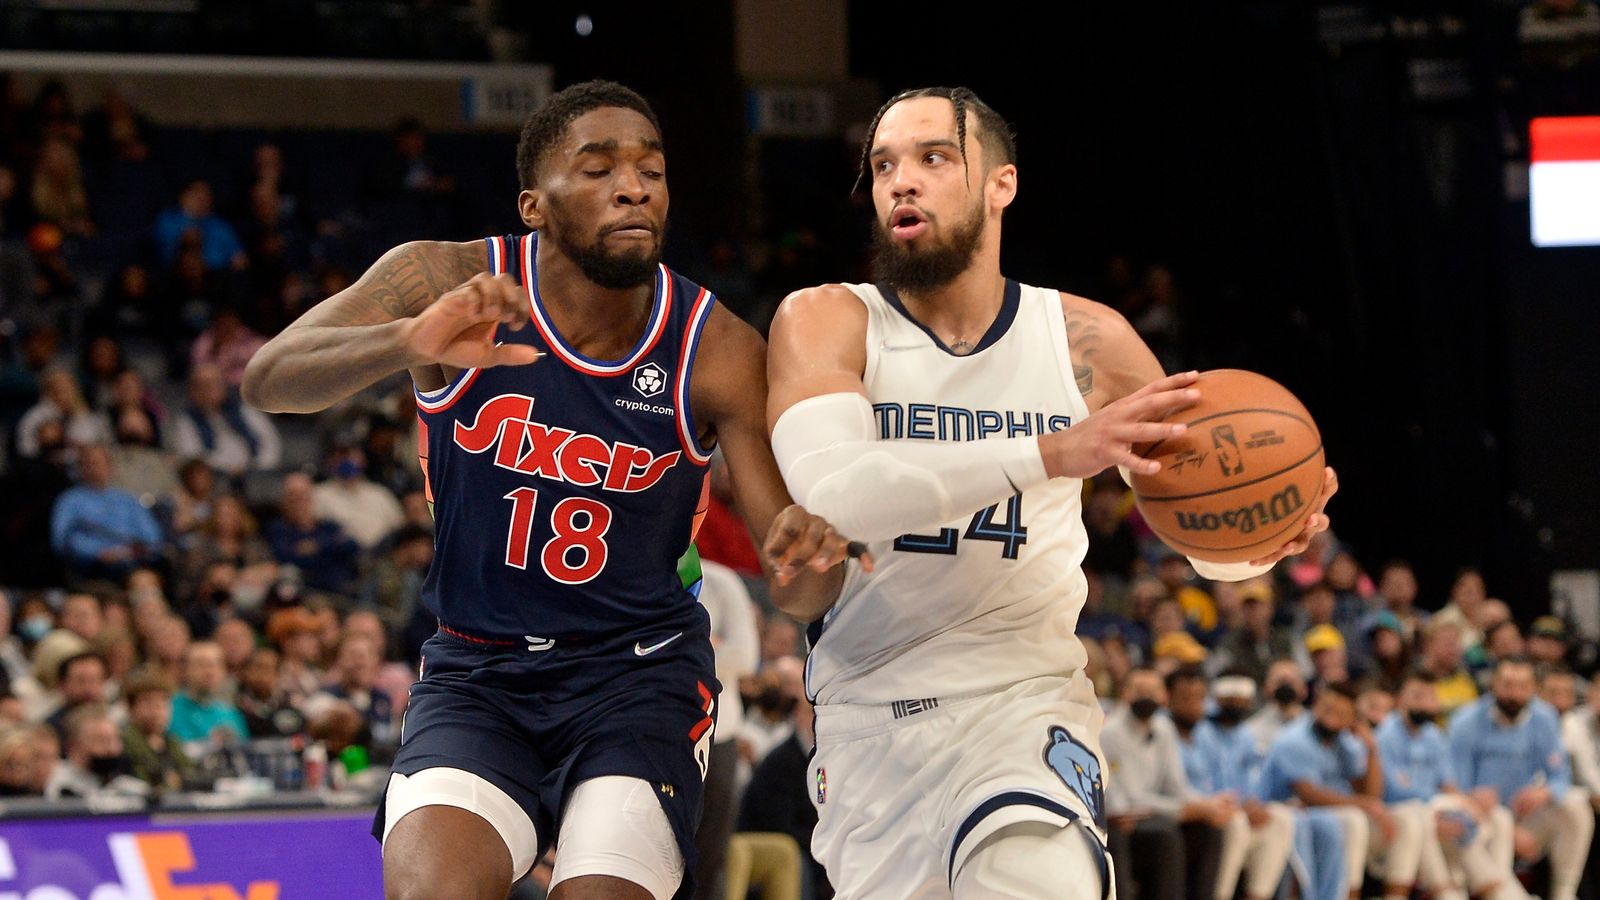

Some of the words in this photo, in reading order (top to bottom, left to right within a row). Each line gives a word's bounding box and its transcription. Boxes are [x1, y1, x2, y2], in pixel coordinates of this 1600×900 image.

[453, 393, 683, 493] Sixers
[614, 398, 675, 417] crypto.com
[502, 486, 613, 585] 18
[1175, 483, 1304, 534] Wilson
